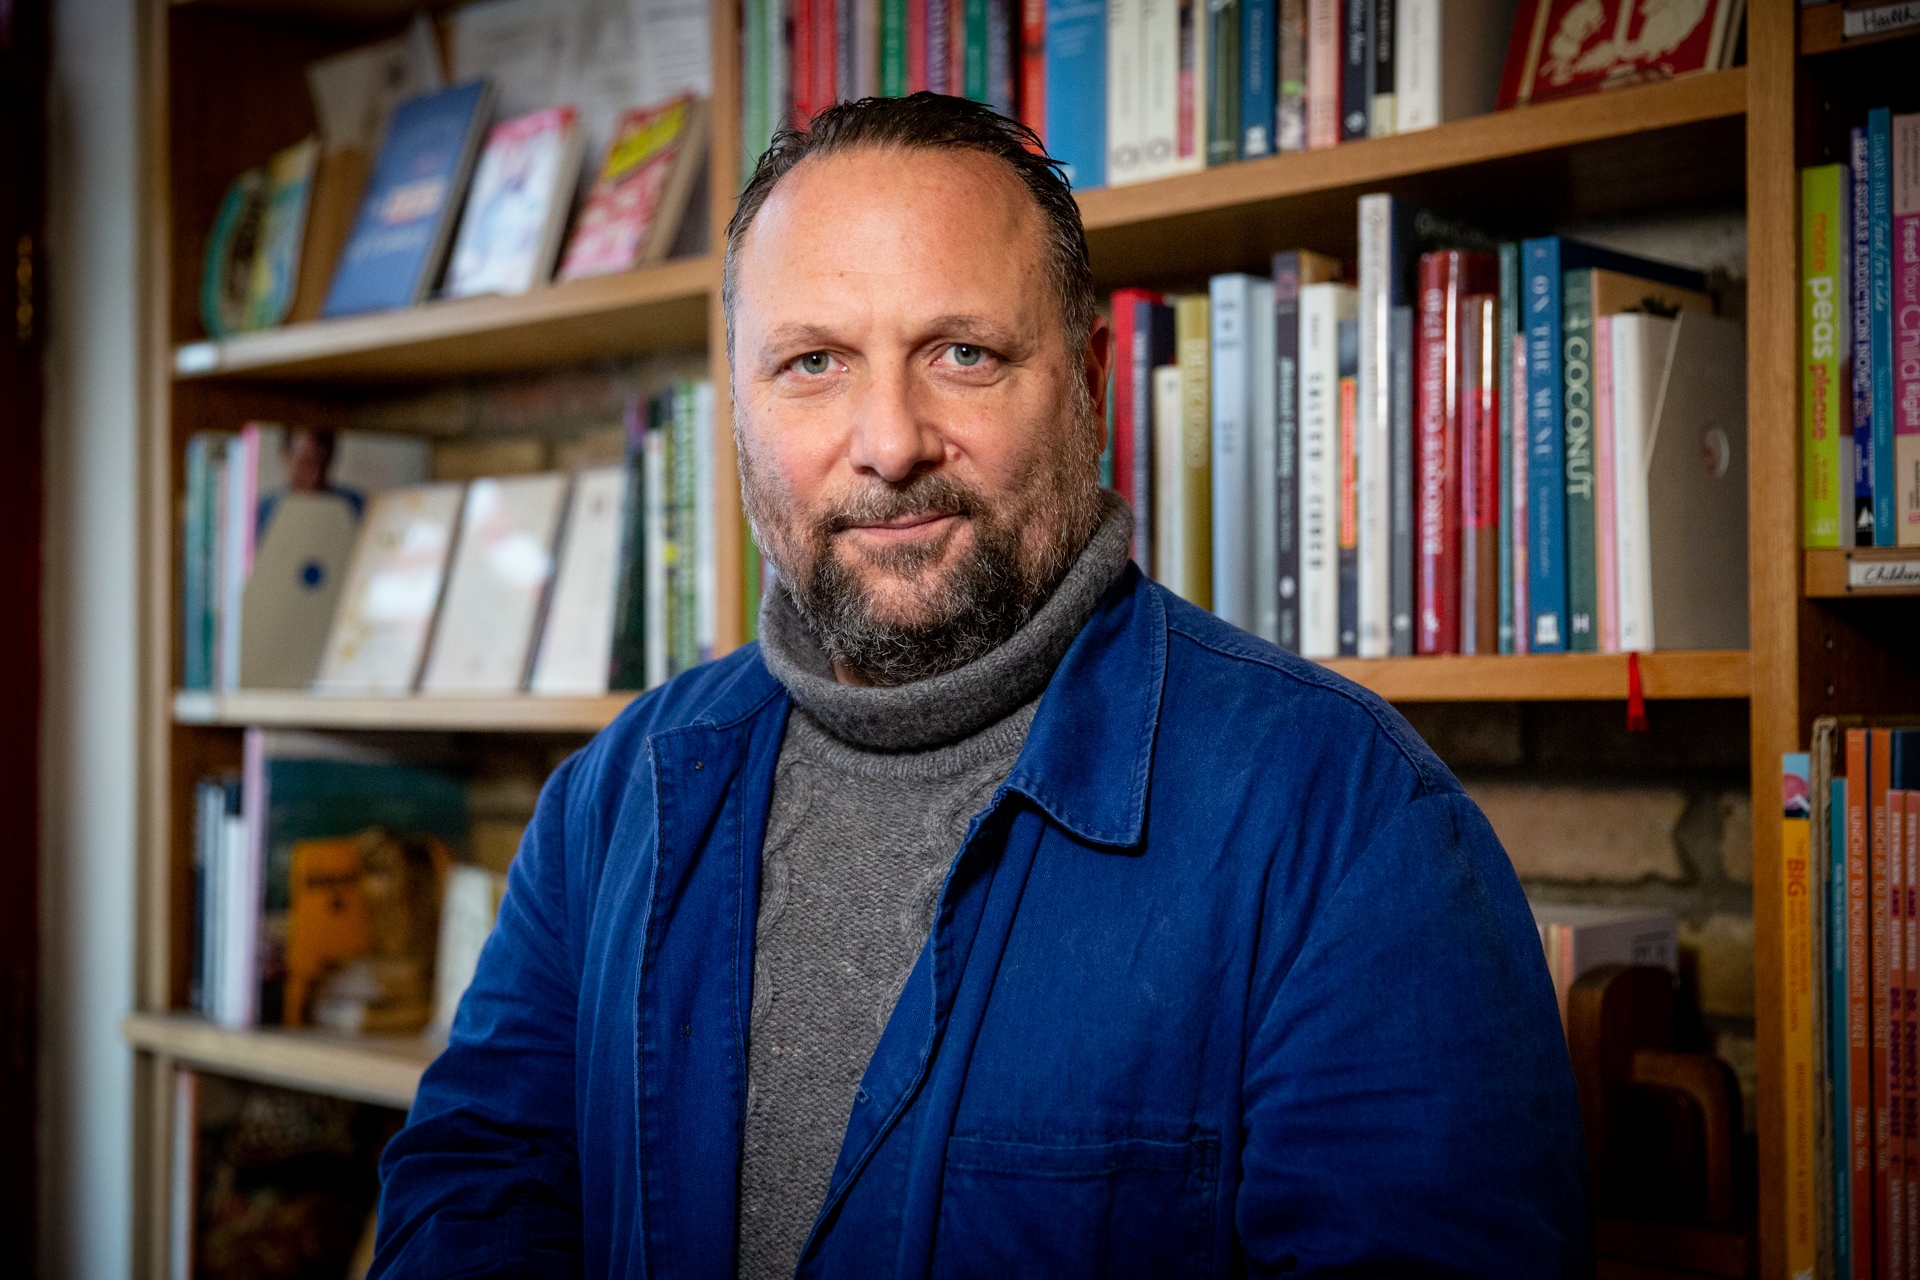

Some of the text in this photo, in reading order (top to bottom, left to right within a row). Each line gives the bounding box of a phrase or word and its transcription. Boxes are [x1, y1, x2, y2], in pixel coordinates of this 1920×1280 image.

[1853, 136, 1868, 182] BEAT
[1854, 183, 1869, 242] SUGAR
[1812, 213, 1827, 272] more
[1903, 218, 1919, 263] Feed
[1531, 275, 1551, 313] ON
[1854, 245, 1870, 342] ADDICTION
[1904, 264, 1919, 304] Your
[1807, 276, 1834, 360] peas
[1531, 321, 1552, 377] THE
[1900, 305, 1920, 380] Child
[1564, 336, 1594, 500] COCONUT
[1807, 364, 1832, 440] please
[1901, 382, 1920, 427] Right
[1850, 805, 1862, 854] LUNCH
[1874, 806, 1886, 854] LUNCH
[1786, 858, 1807, 897] BIG
[1850, 858, 1863, 874] AT
[1850, 880, 1863, 895] 10
[1874, 858, 1886, 874] AT
[1890, 986, 1901, 1016] DR.
[1906, 988, 1917, 1018] DR.
